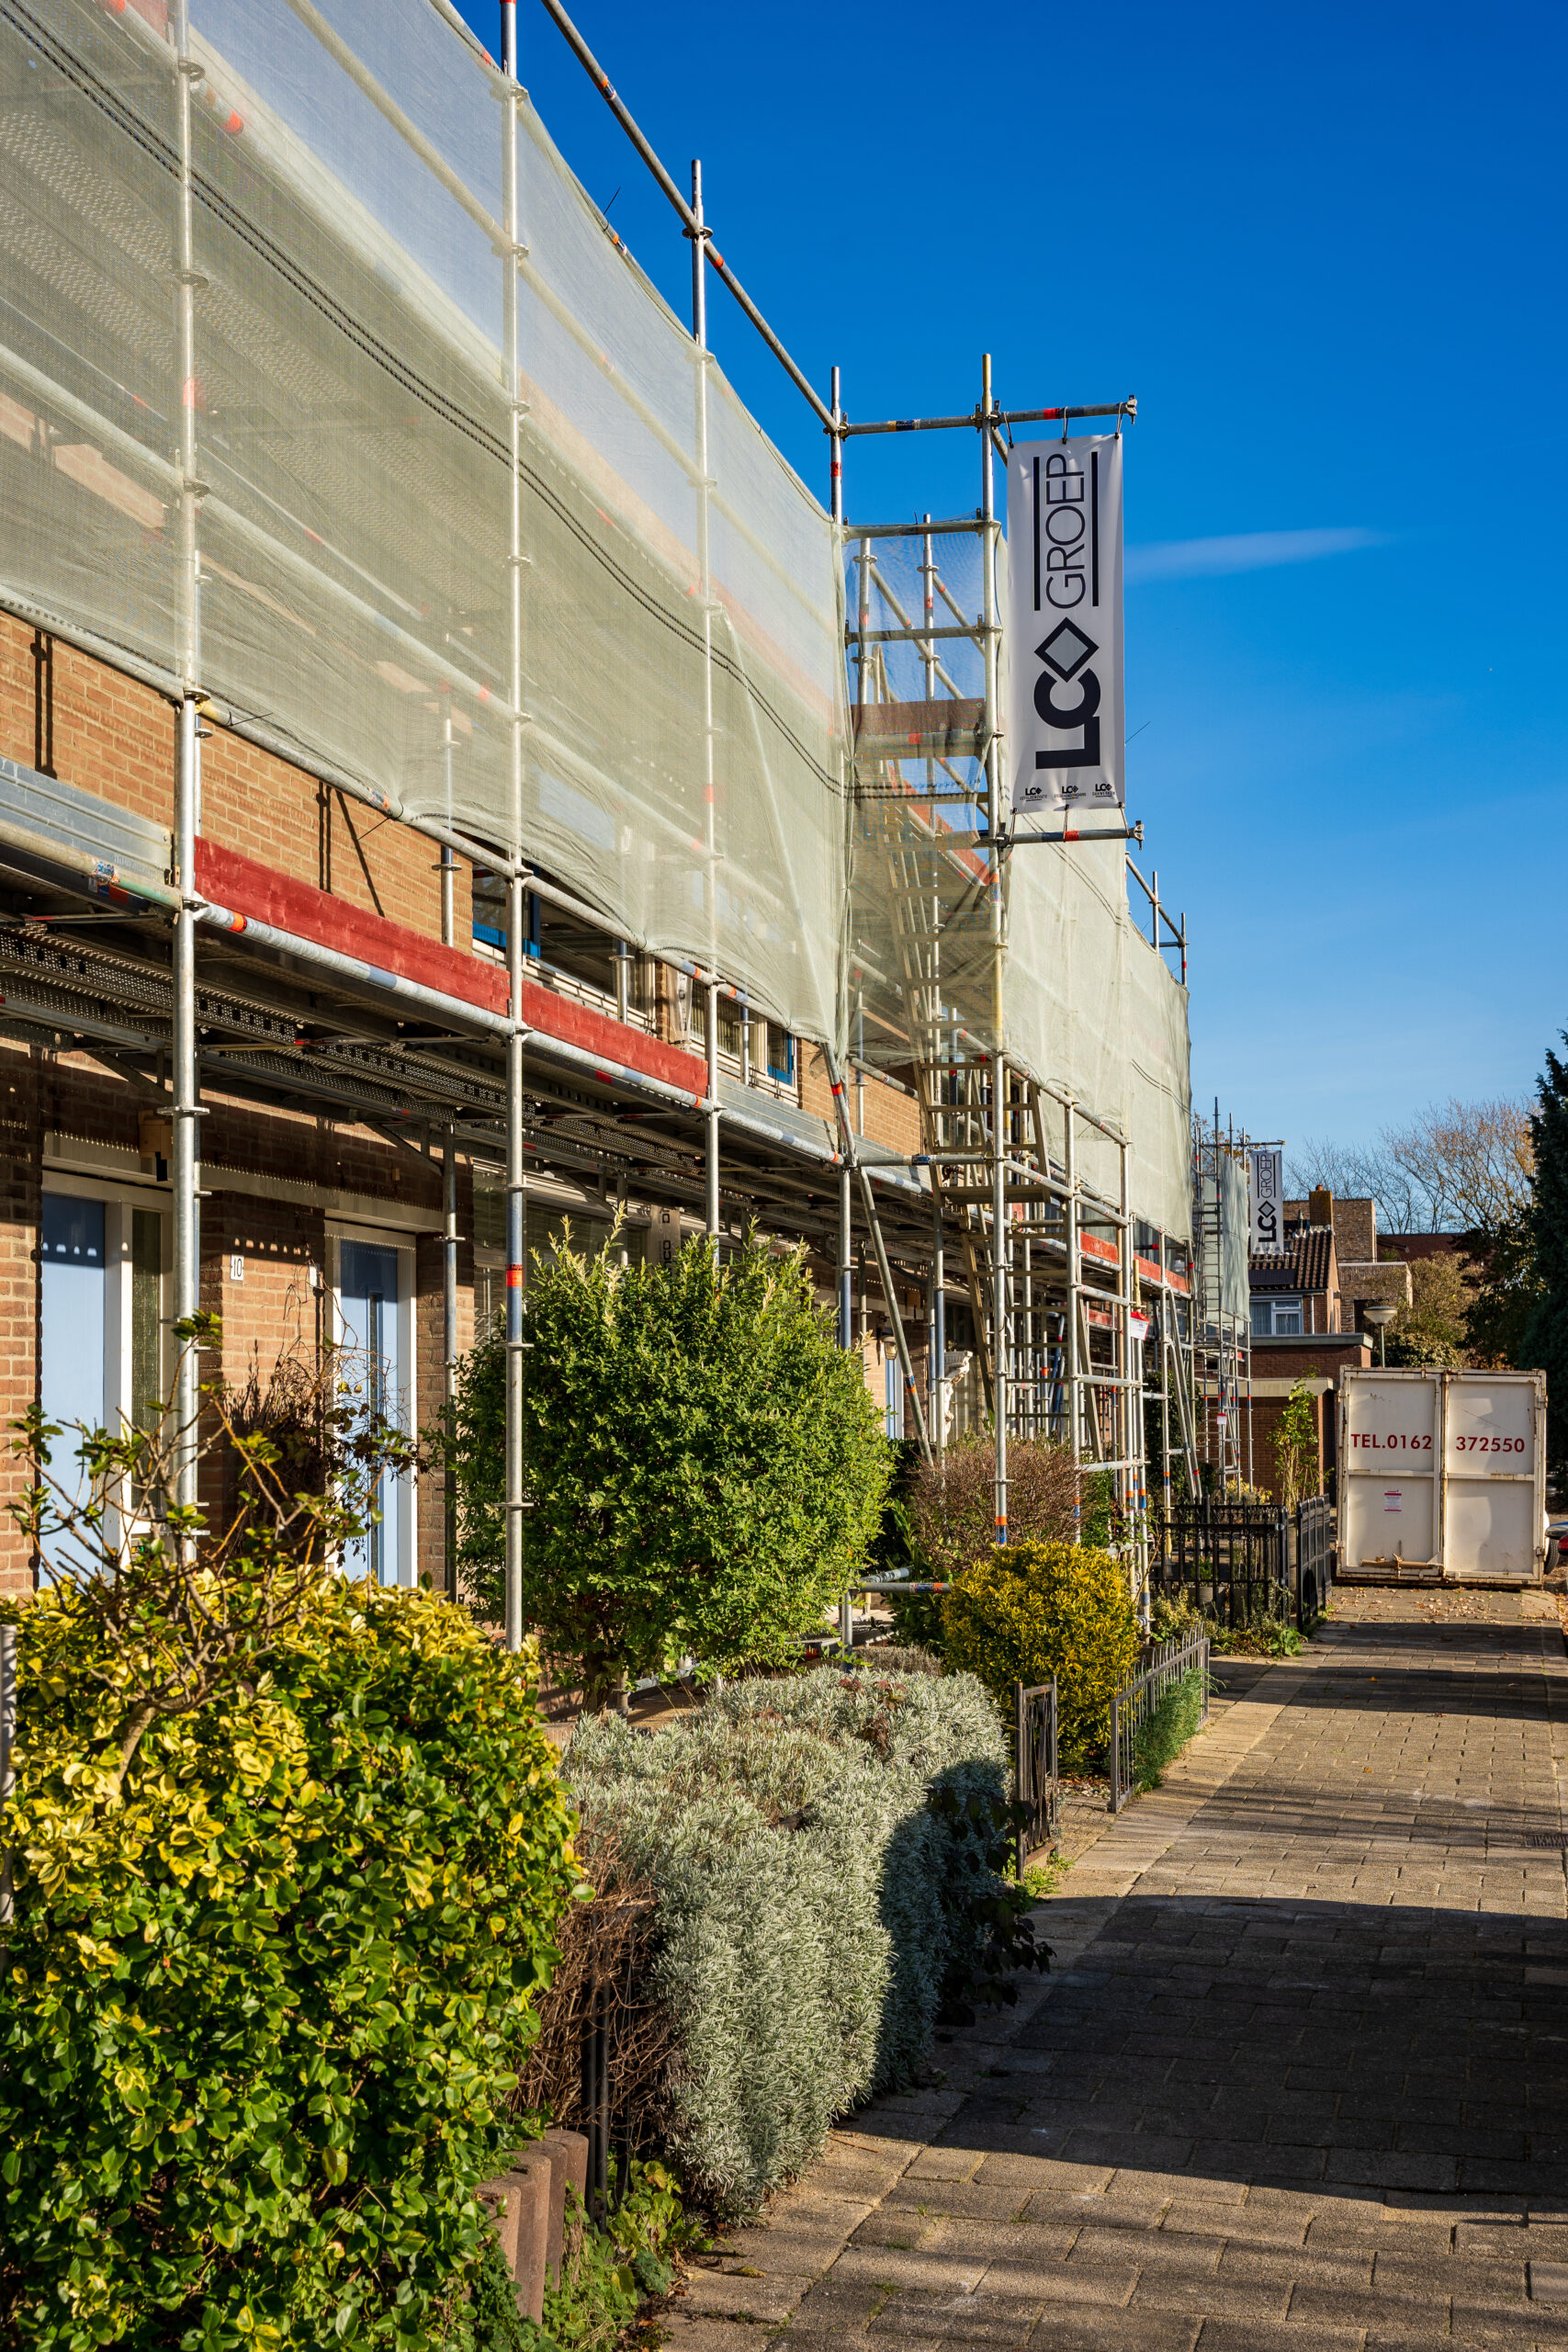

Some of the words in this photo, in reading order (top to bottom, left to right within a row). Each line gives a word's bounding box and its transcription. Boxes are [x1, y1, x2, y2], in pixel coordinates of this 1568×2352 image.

[1045, 453, 1087, 609] GROEP
[1260, 1154, 1273, 1198] GROEP
[233, 1258, 243, 1277] 10
[1350, 1433, 1432, 1450] TEL.0162
[1455, 1436, 1526, 1453] 372550
